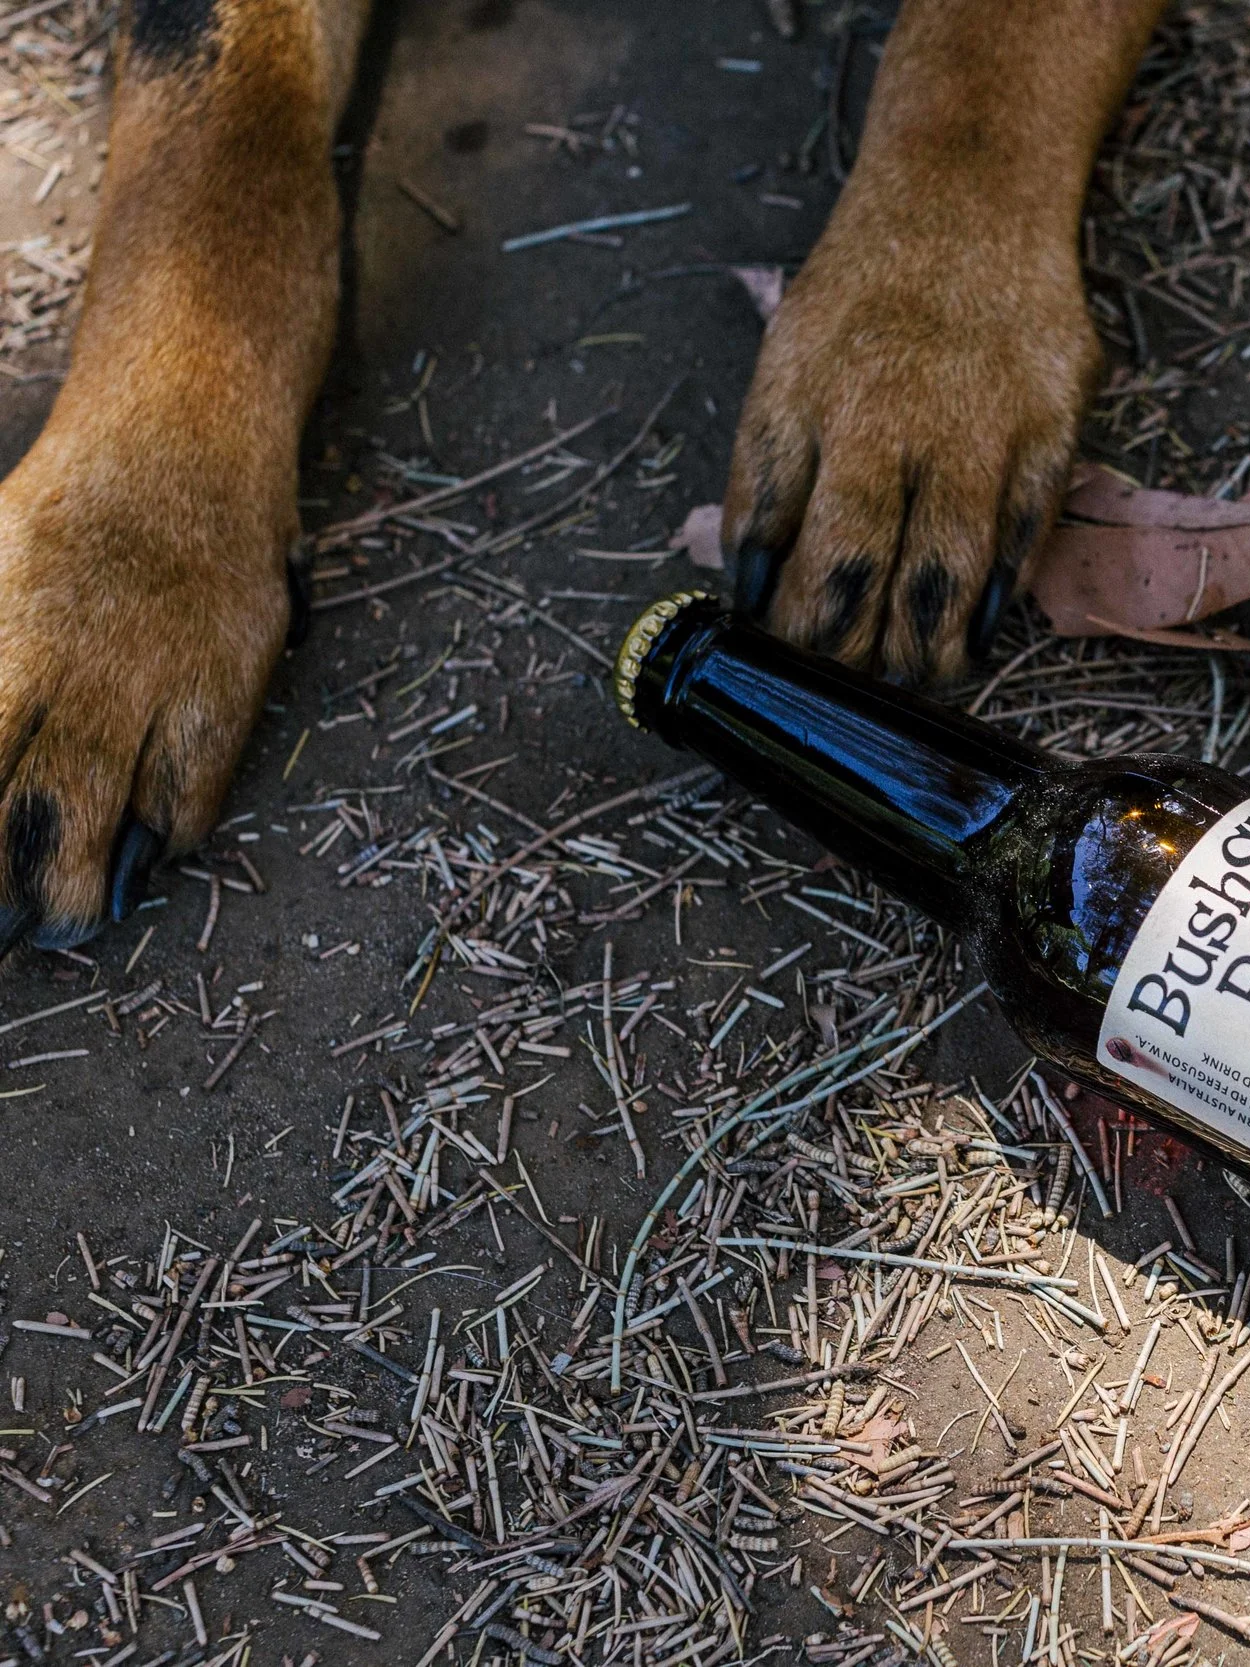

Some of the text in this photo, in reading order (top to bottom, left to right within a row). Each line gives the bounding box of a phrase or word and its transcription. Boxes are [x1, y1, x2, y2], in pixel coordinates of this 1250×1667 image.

[1131, 1034, 1162, 1057] W.A.
[1159, 1050, 1229, 1094] FERGUSON
[1199, 1052, 1242, 1081] DRINK
[1164, 1072, 1236, 1117] AUSTRALIA
[1228, 1088, 1248, 1105] RD
